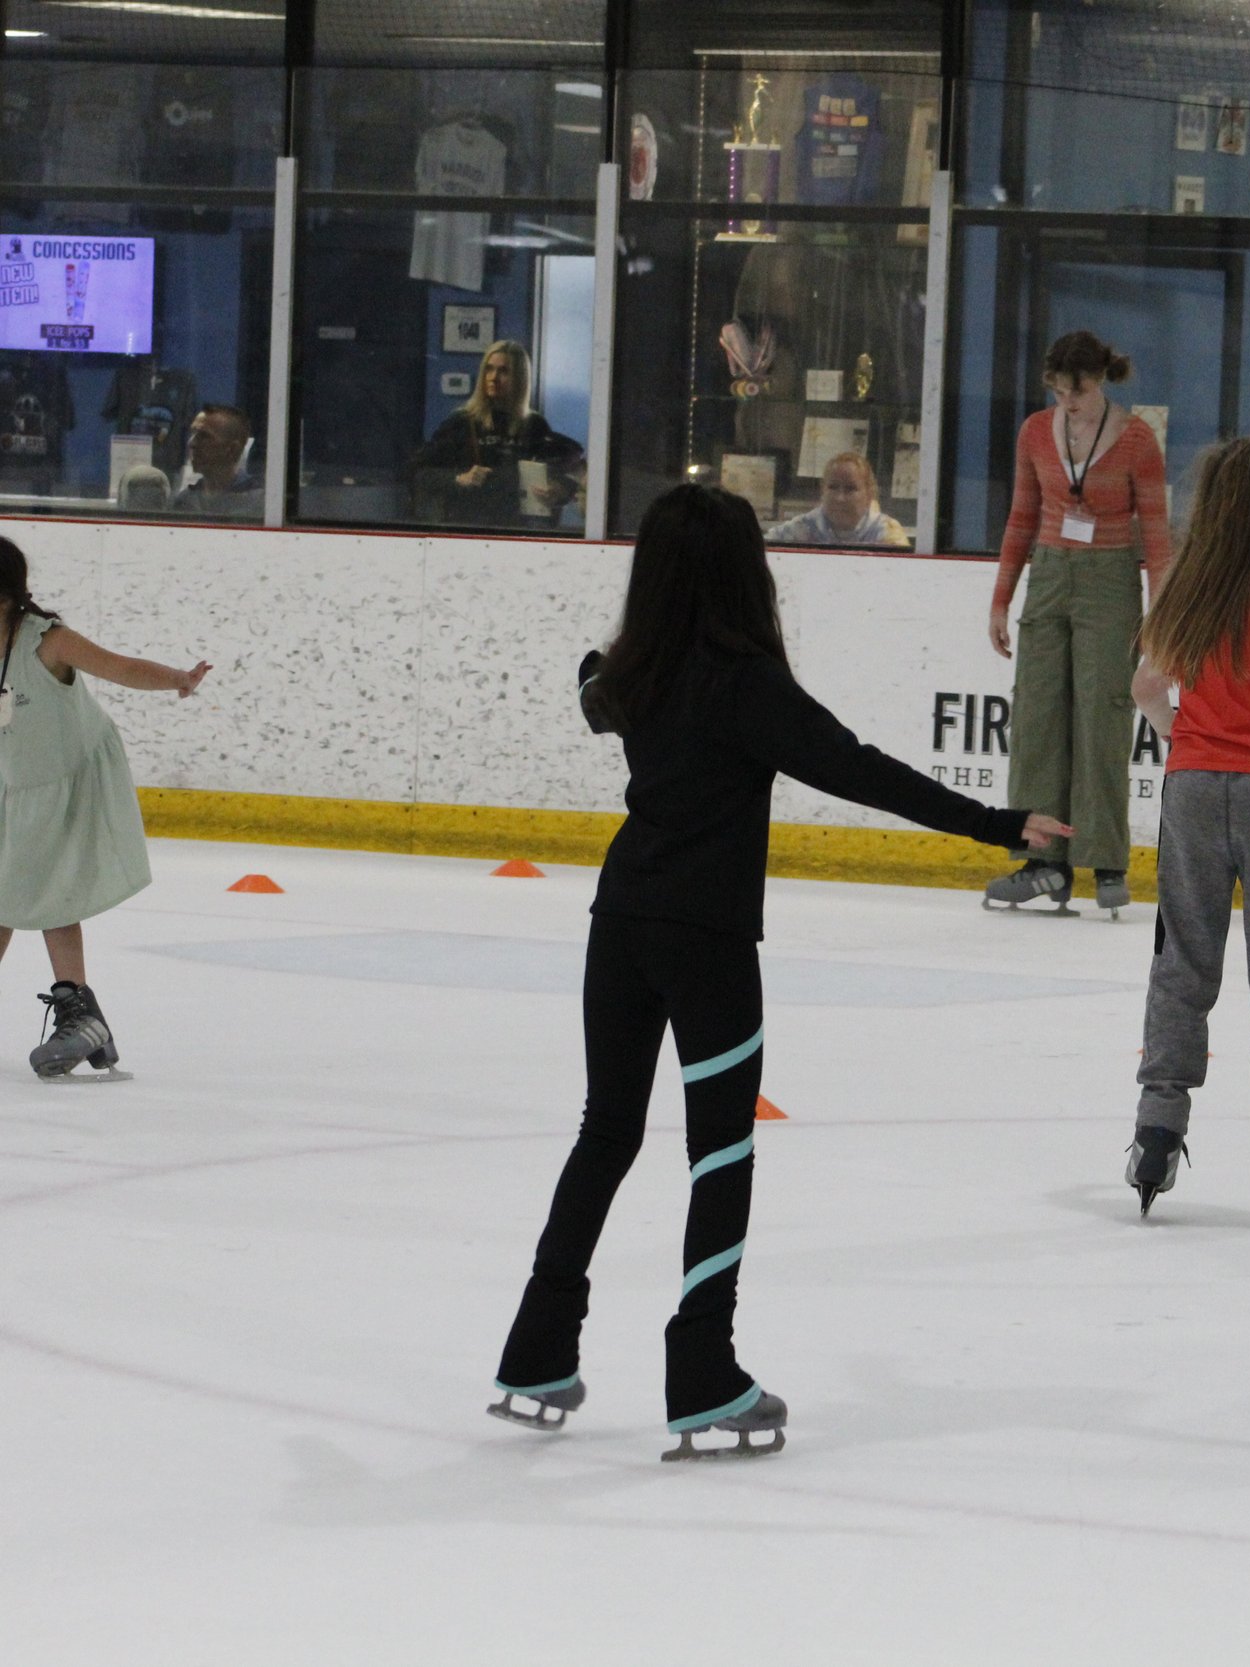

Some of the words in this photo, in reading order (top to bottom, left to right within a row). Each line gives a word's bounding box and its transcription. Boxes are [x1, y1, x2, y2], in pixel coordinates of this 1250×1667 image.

[33, 241, 136, 261] CONCESSIONS
[1, 263, 34, 284] NEW
[932, 692, 1011, 757] FIR
[932, 765, 993, 788] THE
